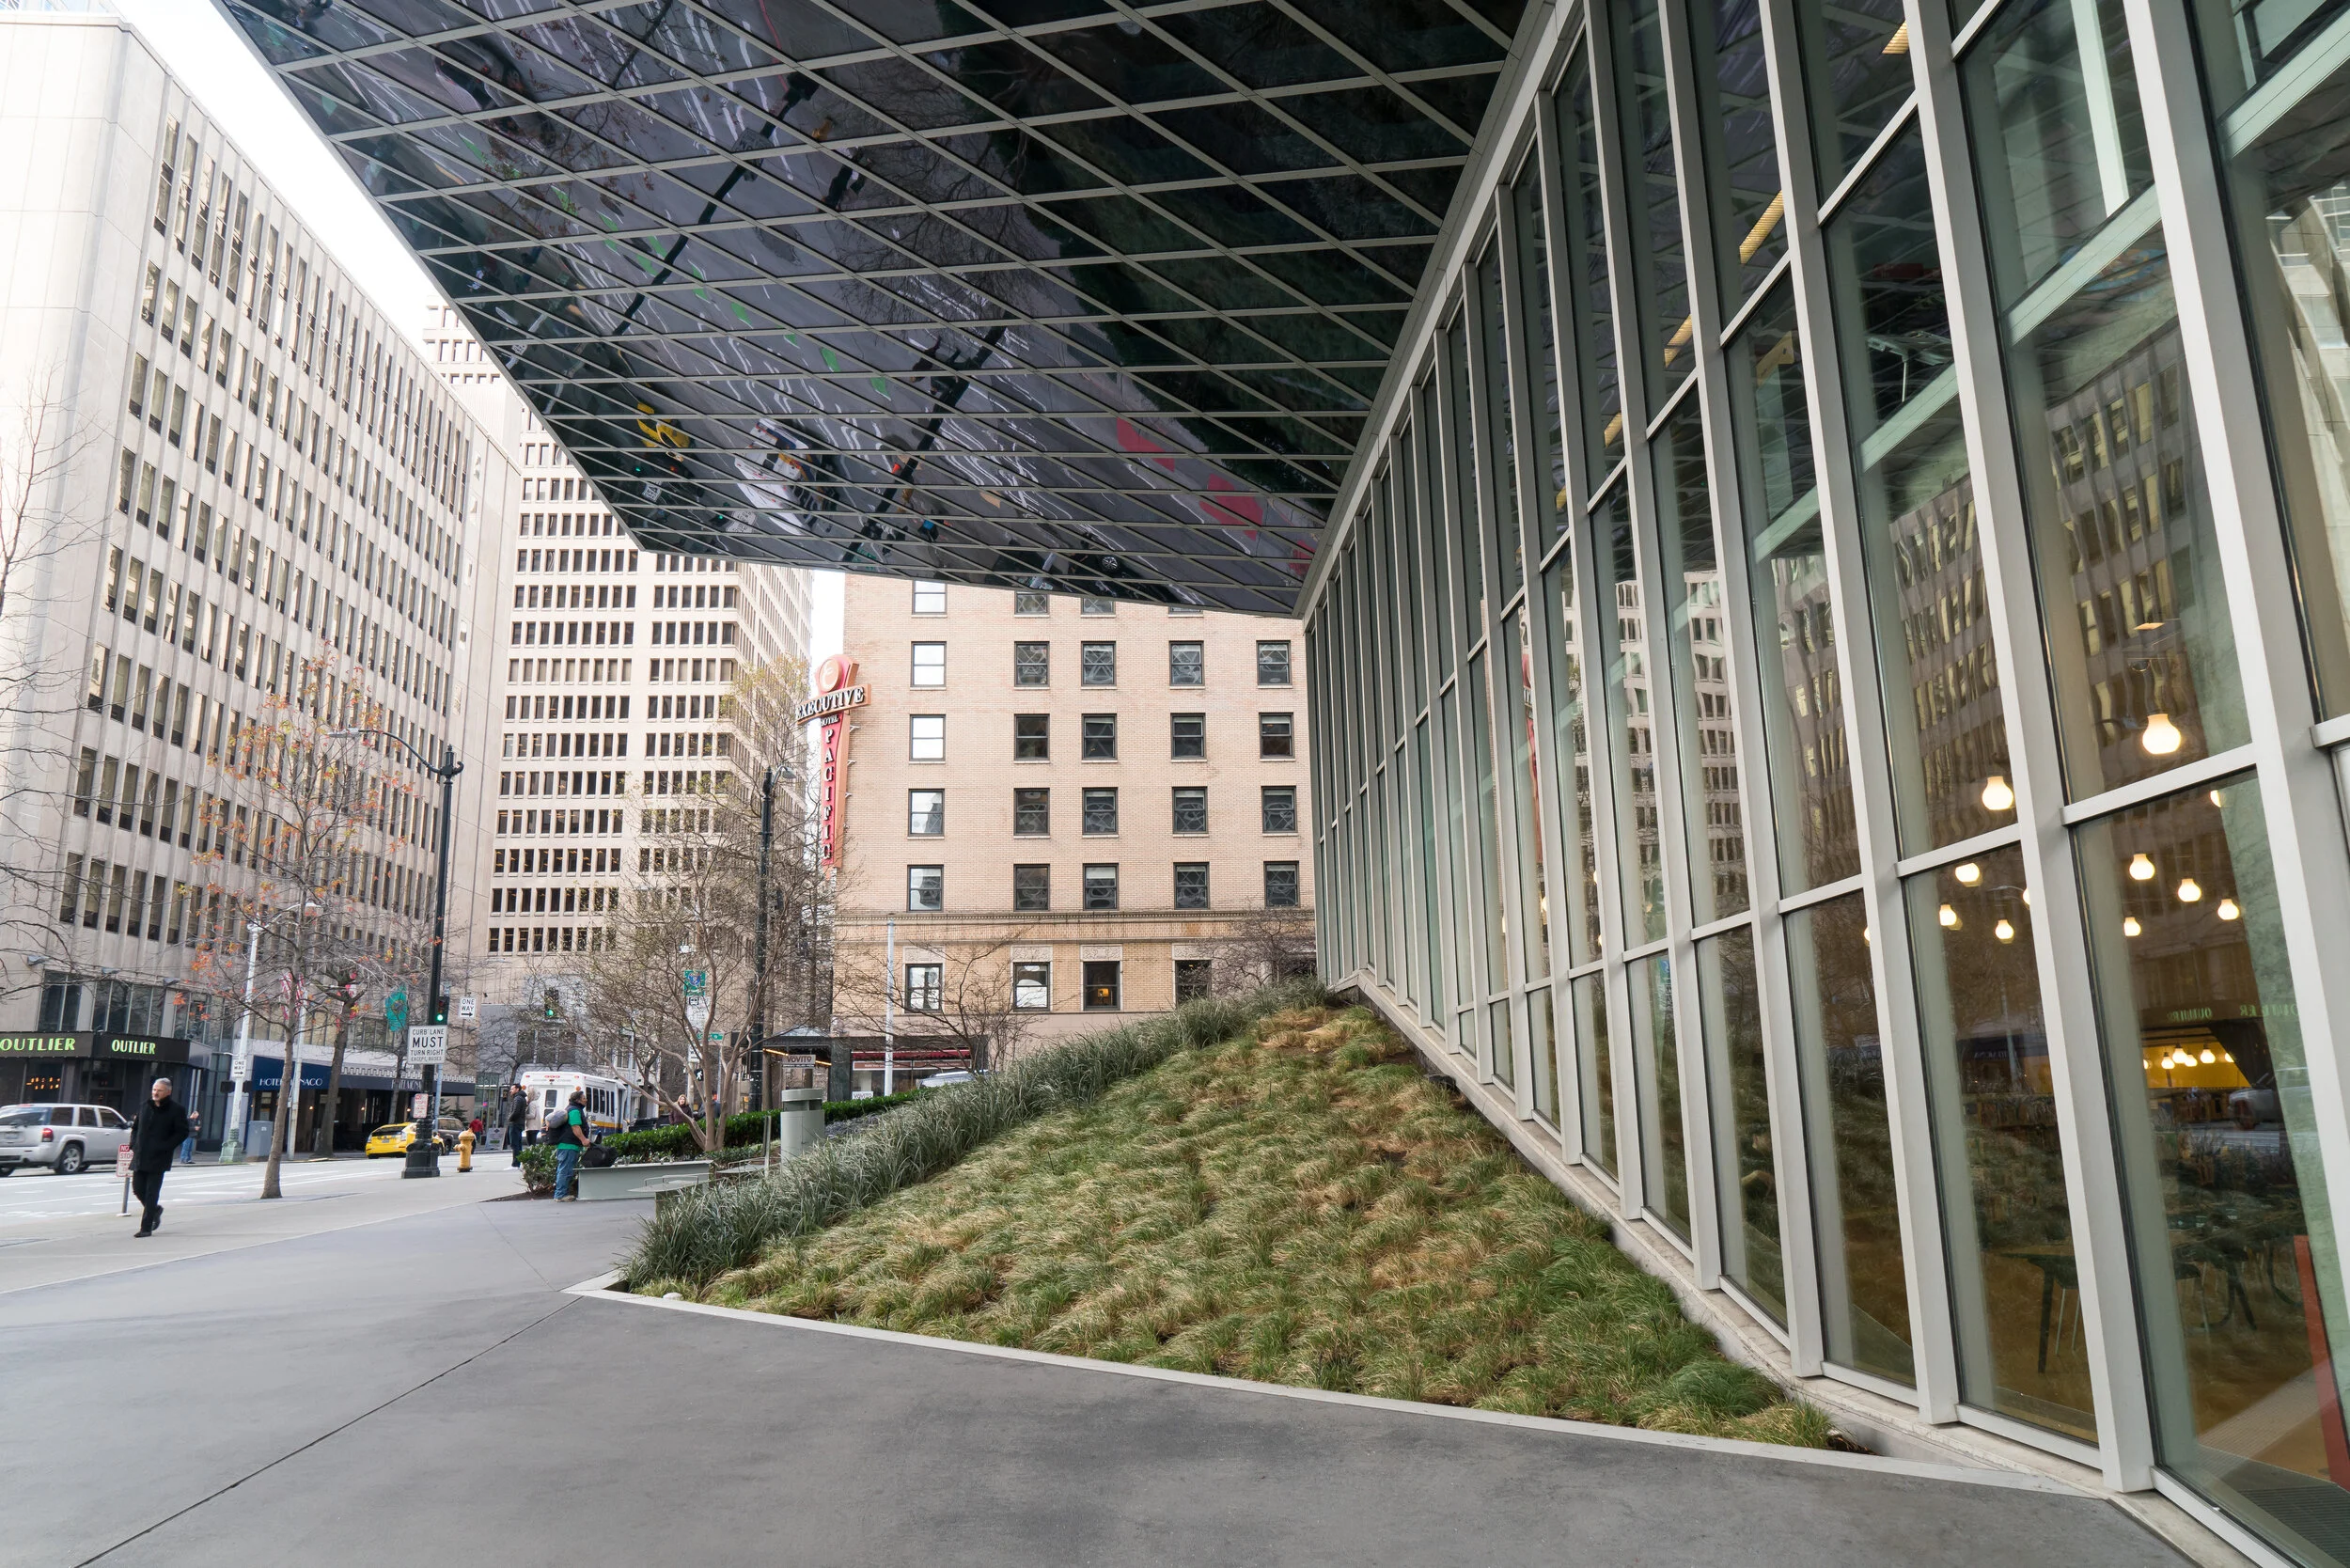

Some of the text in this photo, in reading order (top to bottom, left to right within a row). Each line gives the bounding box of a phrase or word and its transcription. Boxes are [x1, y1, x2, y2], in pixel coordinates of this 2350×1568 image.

[795, 687, 865, 721] EXECUTIVE
[822, 729, 836, 861] PACIFIC
[0, 1037, 76, 1052] OUTLIER
[111, 1039, 156, 1055] OUTLIER
[412, 1037, 444, 1048] MUST
